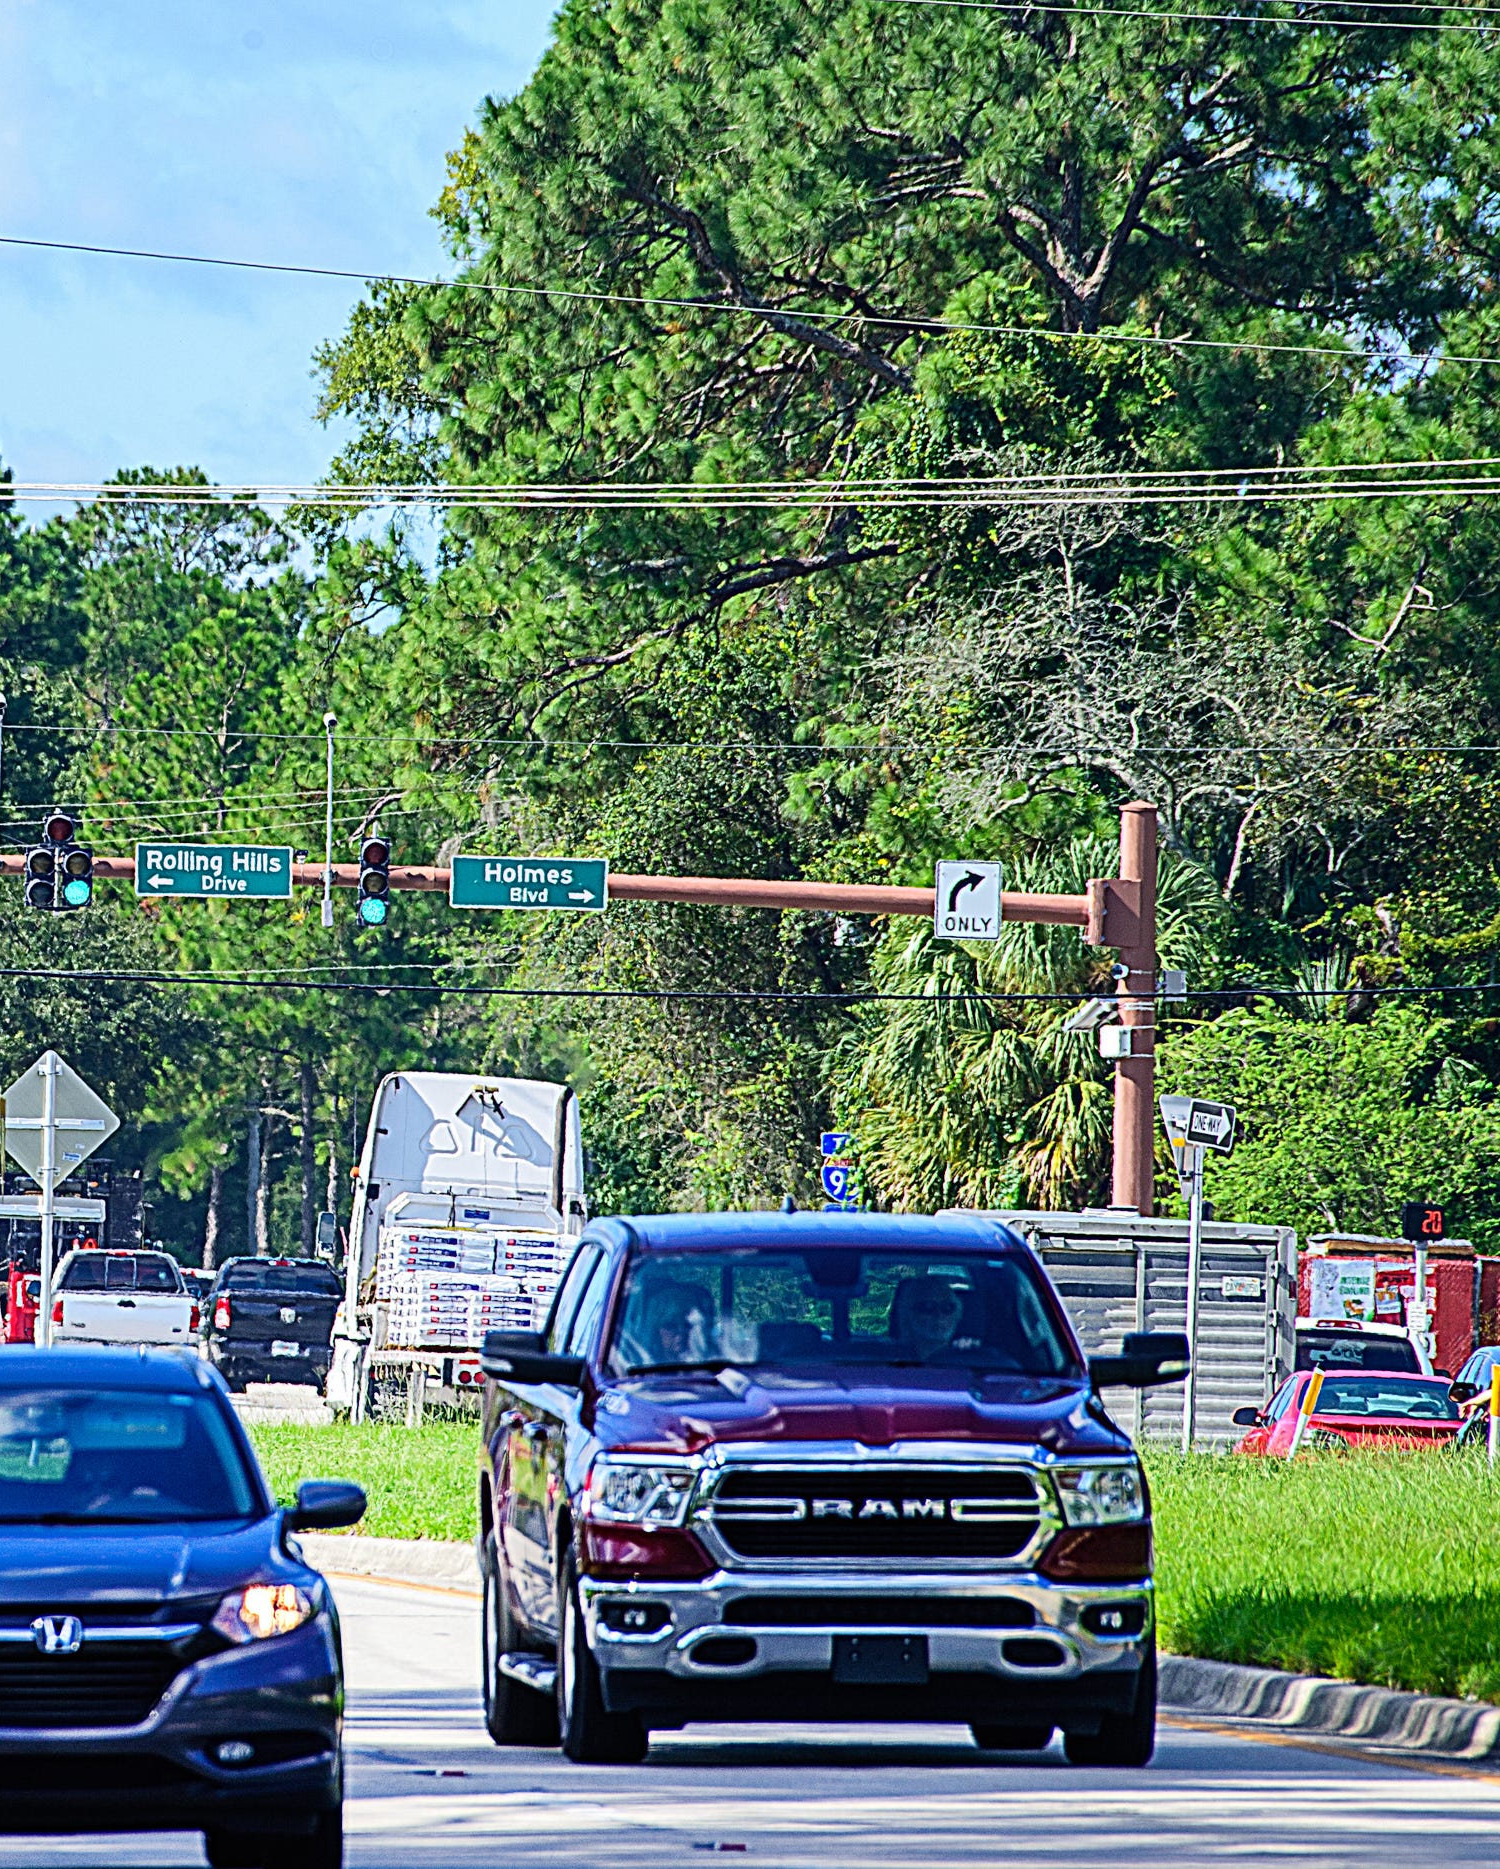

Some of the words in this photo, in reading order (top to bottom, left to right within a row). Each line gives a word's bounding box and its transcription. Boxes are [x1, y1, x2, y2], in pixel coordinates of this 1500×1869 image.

[146, 850, 223, 877] Rolling
[232, 851, 282, 874] Hills
[484, 862, 574, 885] Holmes
[201, 875, 248, 892] Drive
[509, 887, 549, 903] Blvd
[945, 916, 992, 932] ONLY
[1193, 1113, 1207, 1131] ONE
[1207, 1117, 1222, 1133] WAY
[1421, 1210, 1442, 1234] 20
[812, 1498, 945, 1519] RAM
